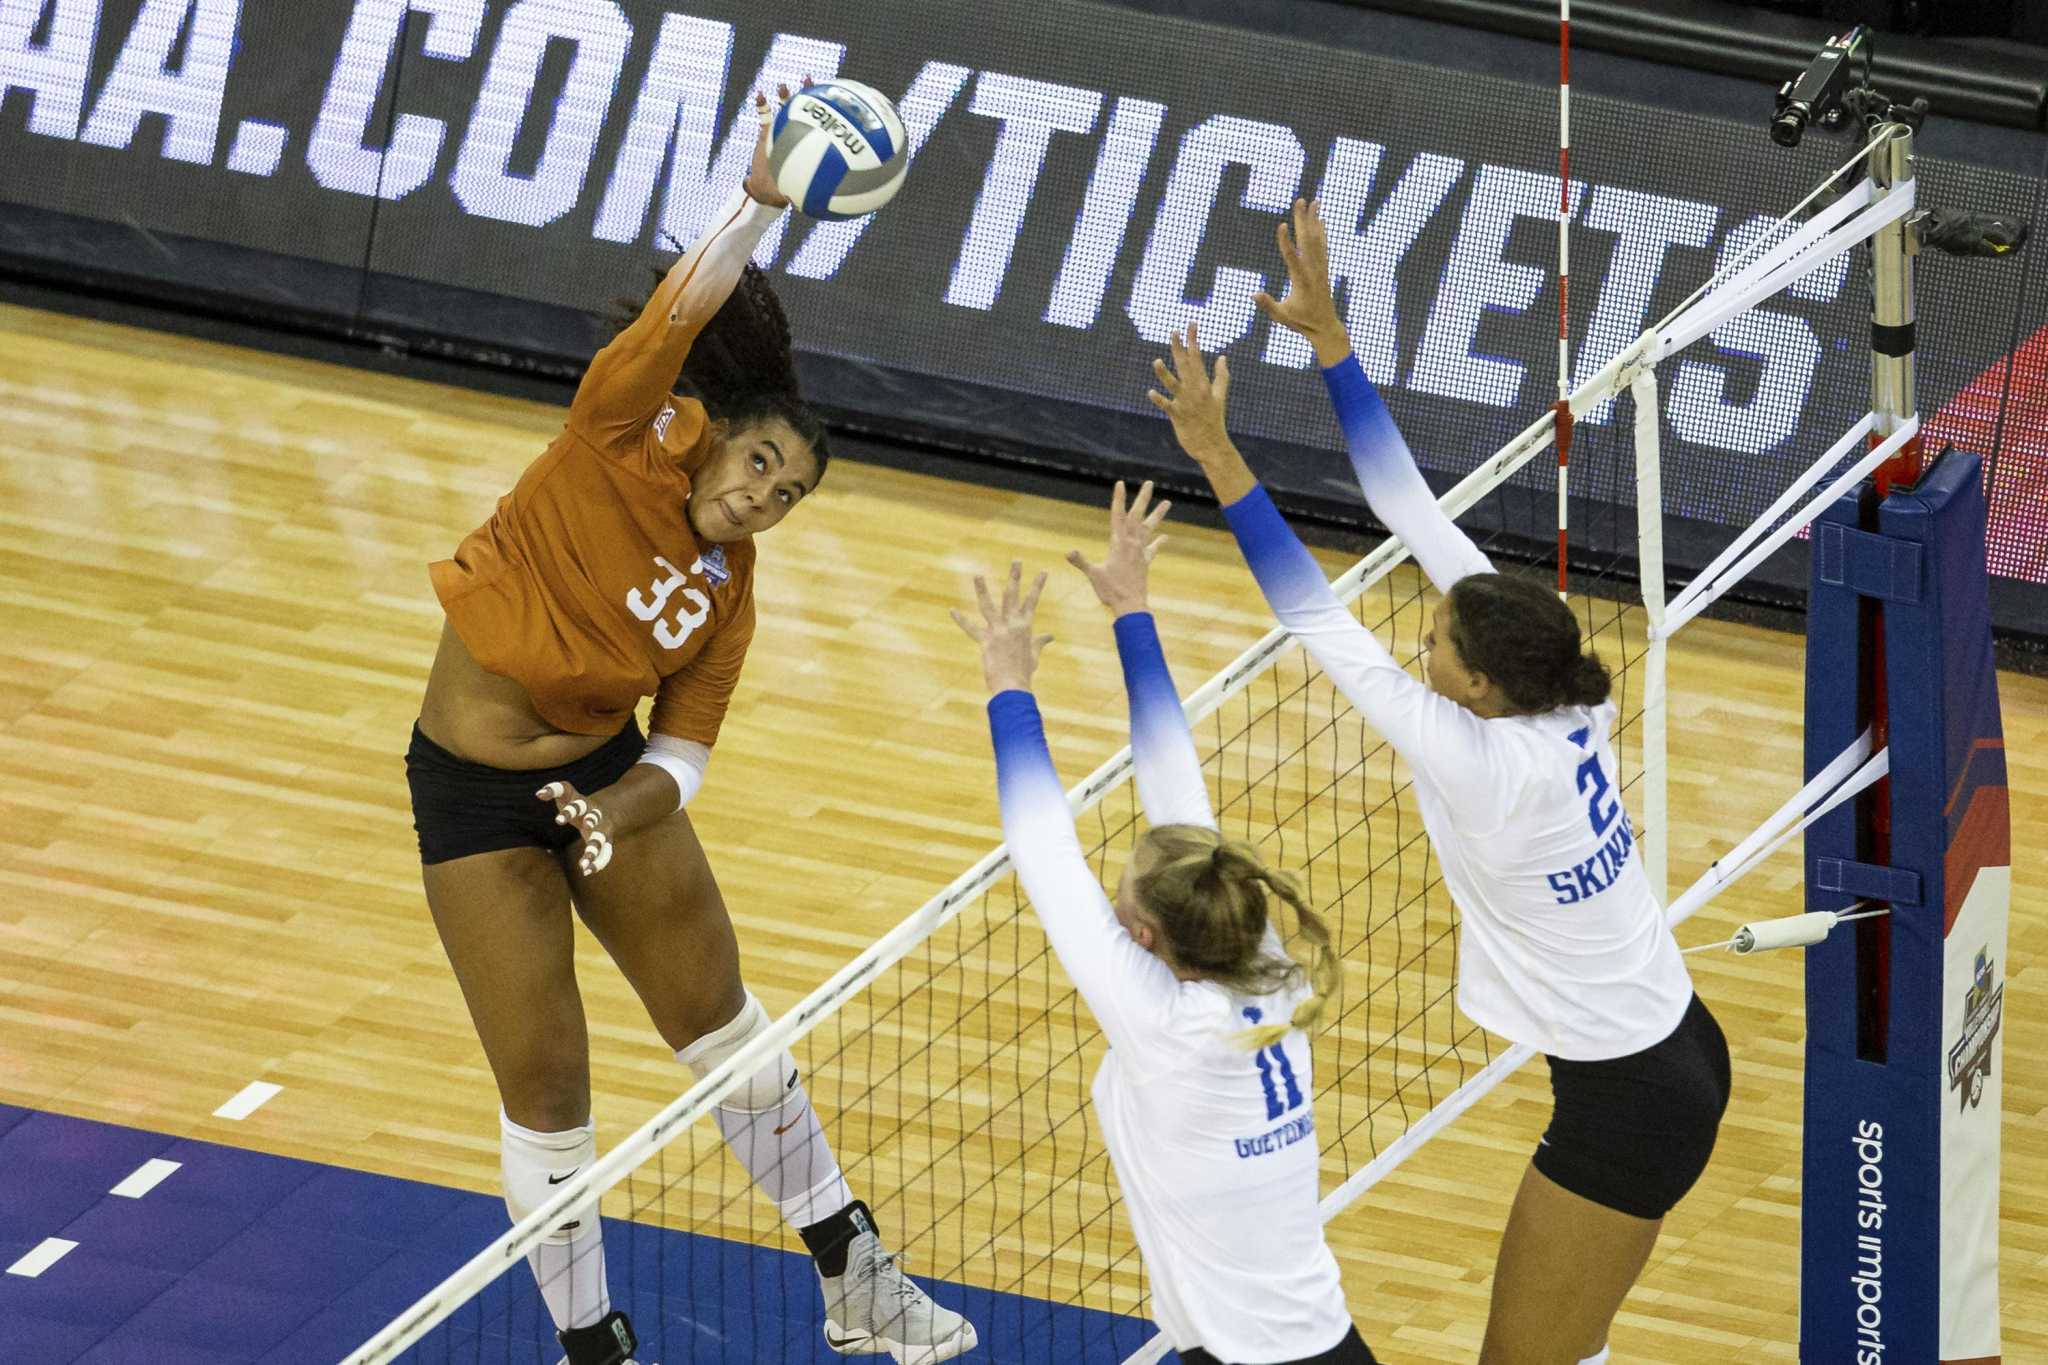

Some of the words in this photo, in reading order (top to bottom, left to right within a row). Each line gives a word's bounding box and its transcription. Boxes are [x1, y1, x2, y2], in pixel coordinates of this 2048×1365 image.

[802, 100, 866, 156] molten
[626, 554, 711, 650] 33
[1577, 751, 1620, 839] 2
[1546, 808, 1635, 905] SKINN
[1256, 1041, 1303, 1121] 11
[1851, 1119, 1888, 1230] sports
[1850, 1235, 1887, 1365] imports
